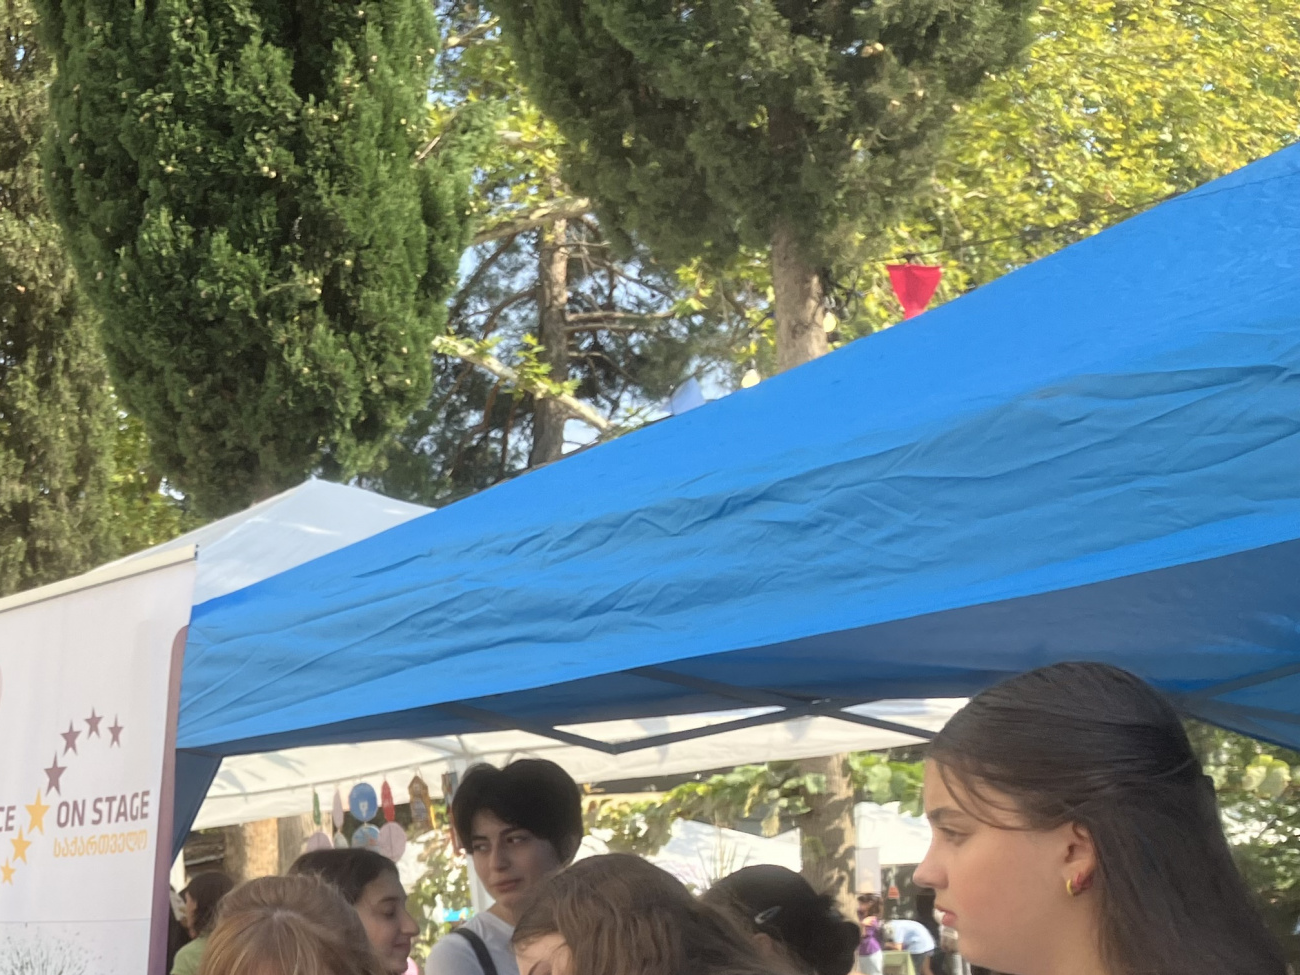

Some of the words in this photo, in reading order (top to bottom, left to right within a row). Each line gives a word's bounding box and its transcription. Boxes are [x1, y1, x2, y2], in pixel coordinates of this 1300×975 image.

[56, 799, 86, 828] ON
[91, 790, 151, 826] STAGE
[53, 829, 148, 858] საქართველო
